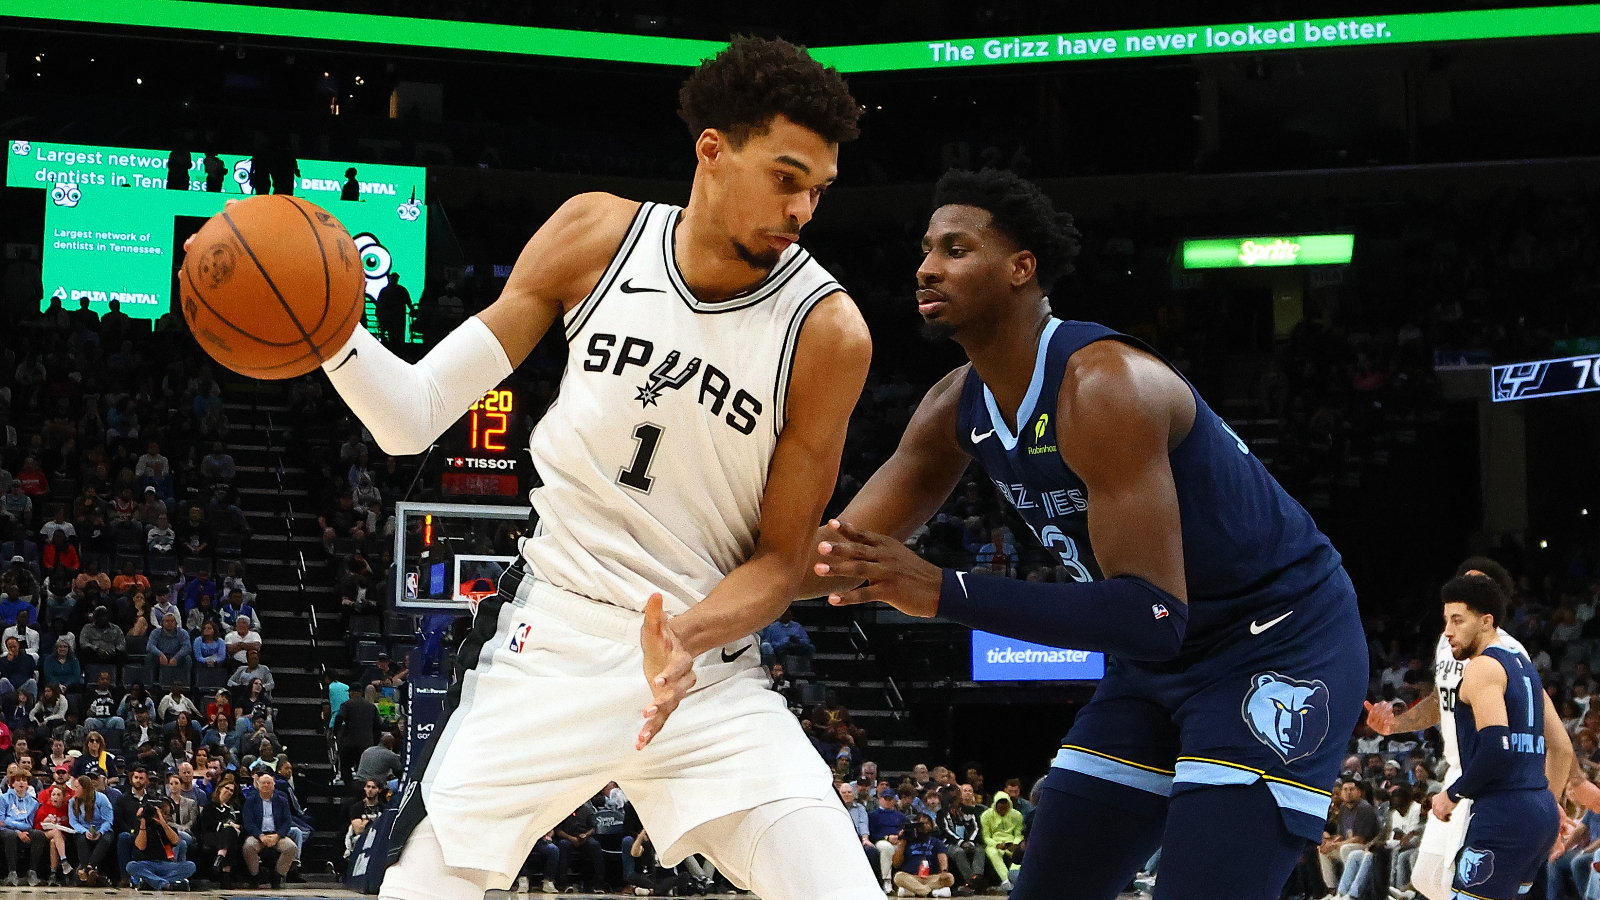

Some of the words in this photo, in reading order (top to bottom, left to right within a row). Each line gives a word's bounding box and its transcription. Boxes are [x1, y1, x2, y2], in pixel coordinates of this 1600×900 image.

[928, 42, 975, 62] The
[983, 37, 1049, 60] Grizz
[1057, 35, 1117, 56] have
[1126, 33, 1197, 52] never
[1206, 23, 1295, 47] looked
[1304, 20, 1391, 42] better.
[36, 147, 103, 166] Largest
[108, 152, 169, 169] networ
[35, 167, 105, 185] dentists
[111, 172, 127, 186] in
[301, 178, 341, 192] DELTA
[344, 181, 396, 196] NTAL
[54, 228, 93, 240] Largest
[95, 231, 137, 242] network
[139, 233, 151, 242] of
[53, 240, 94, 251] dentists
[97, 242, 106, 251] in
[109, 243, 164, 255] Tennessee.
[1239, 239, 1300, 265] Sprite
[70, 289, 108, 302] DELTA
[109, 291, 158, 305] DENTAL
[583, 332, 763, 436] SPURS
[469, 390, 513, 412] :20
[471, 412, 507, 450] 12
[464, 457, 517, 470] TISSOT
[614, 420, 667, 497] 1
[986, 646, 1092, 664] ticketmaster
[1523, 675, 1535, 728] 1
